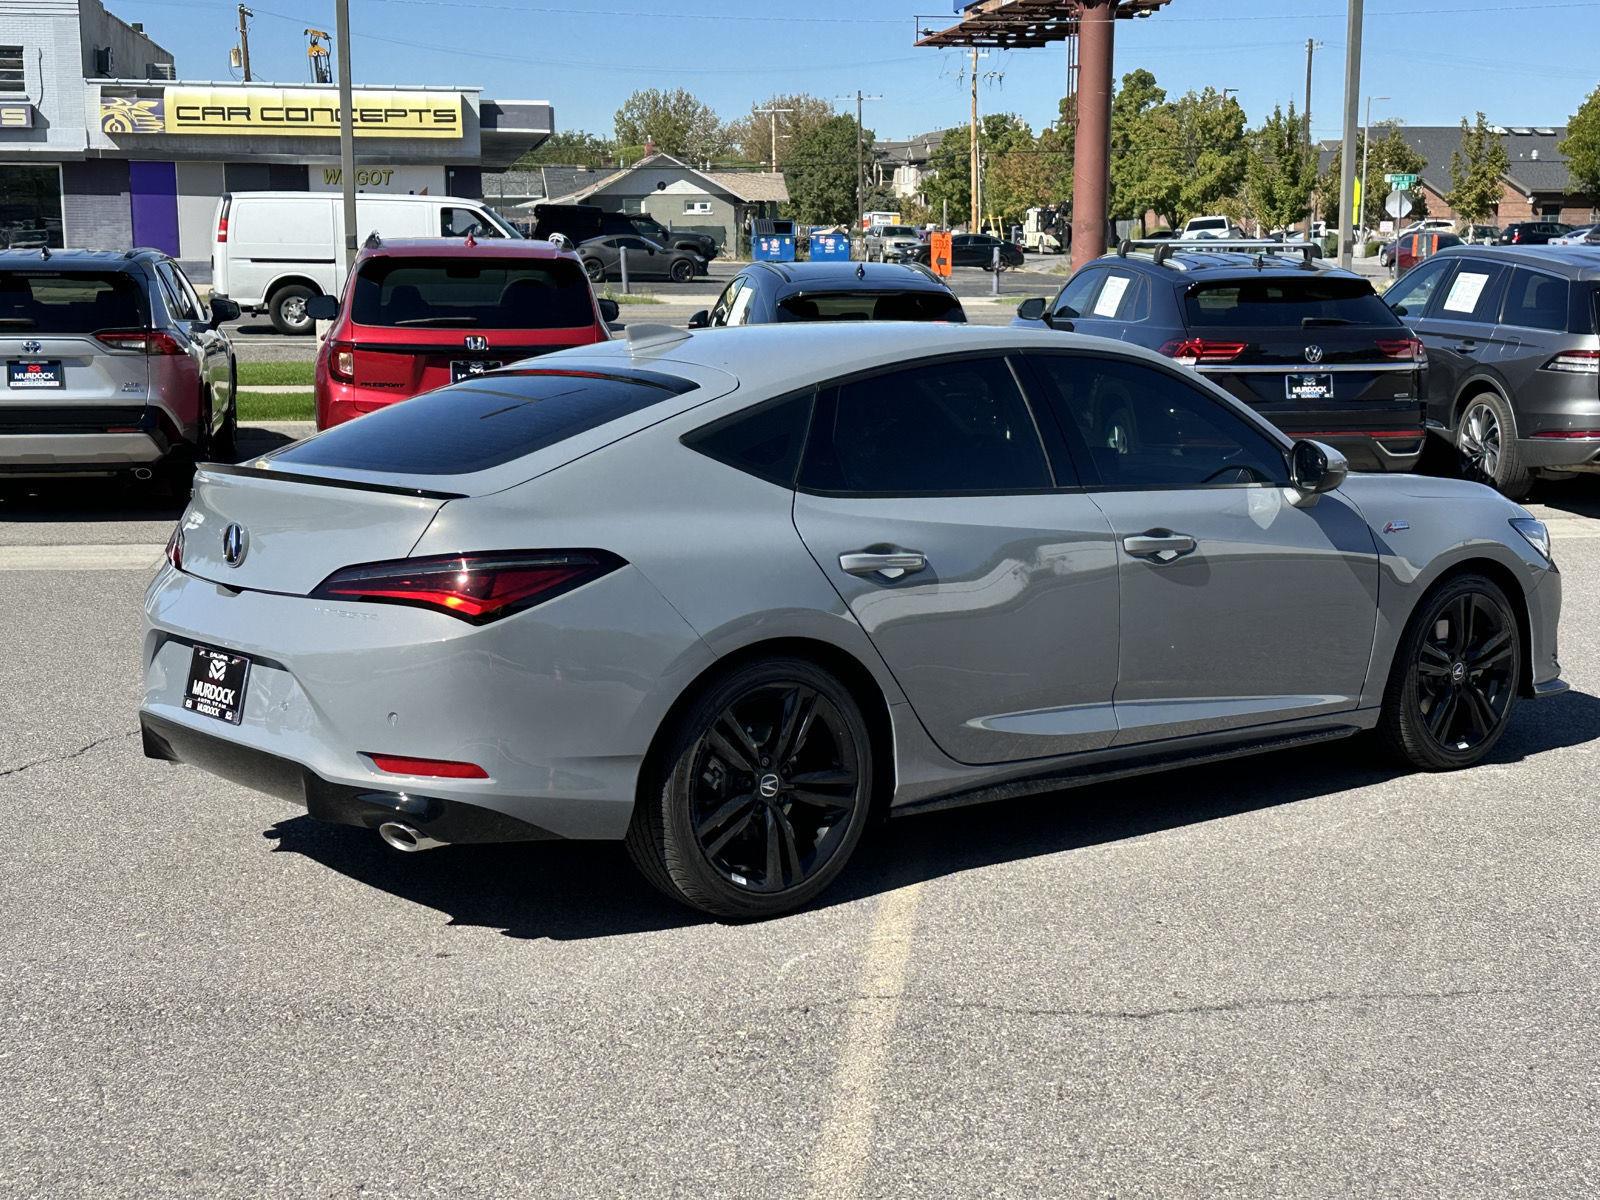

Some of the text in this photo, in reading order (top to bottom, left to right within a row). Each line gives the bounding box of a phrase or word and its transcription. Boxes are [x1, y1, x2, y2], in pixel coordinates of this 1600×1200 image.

[176, 106, 457, 123] CAR CONCEPTS
[356, 169, 394, 186] GOT
[14, 372, 54, 380] MURDOCK
[1292, 386, 1327, 394] MURDOCK
[192, 679, 236, 706] MURDOCK
[196, 702, 221, 717] MURDOCK
